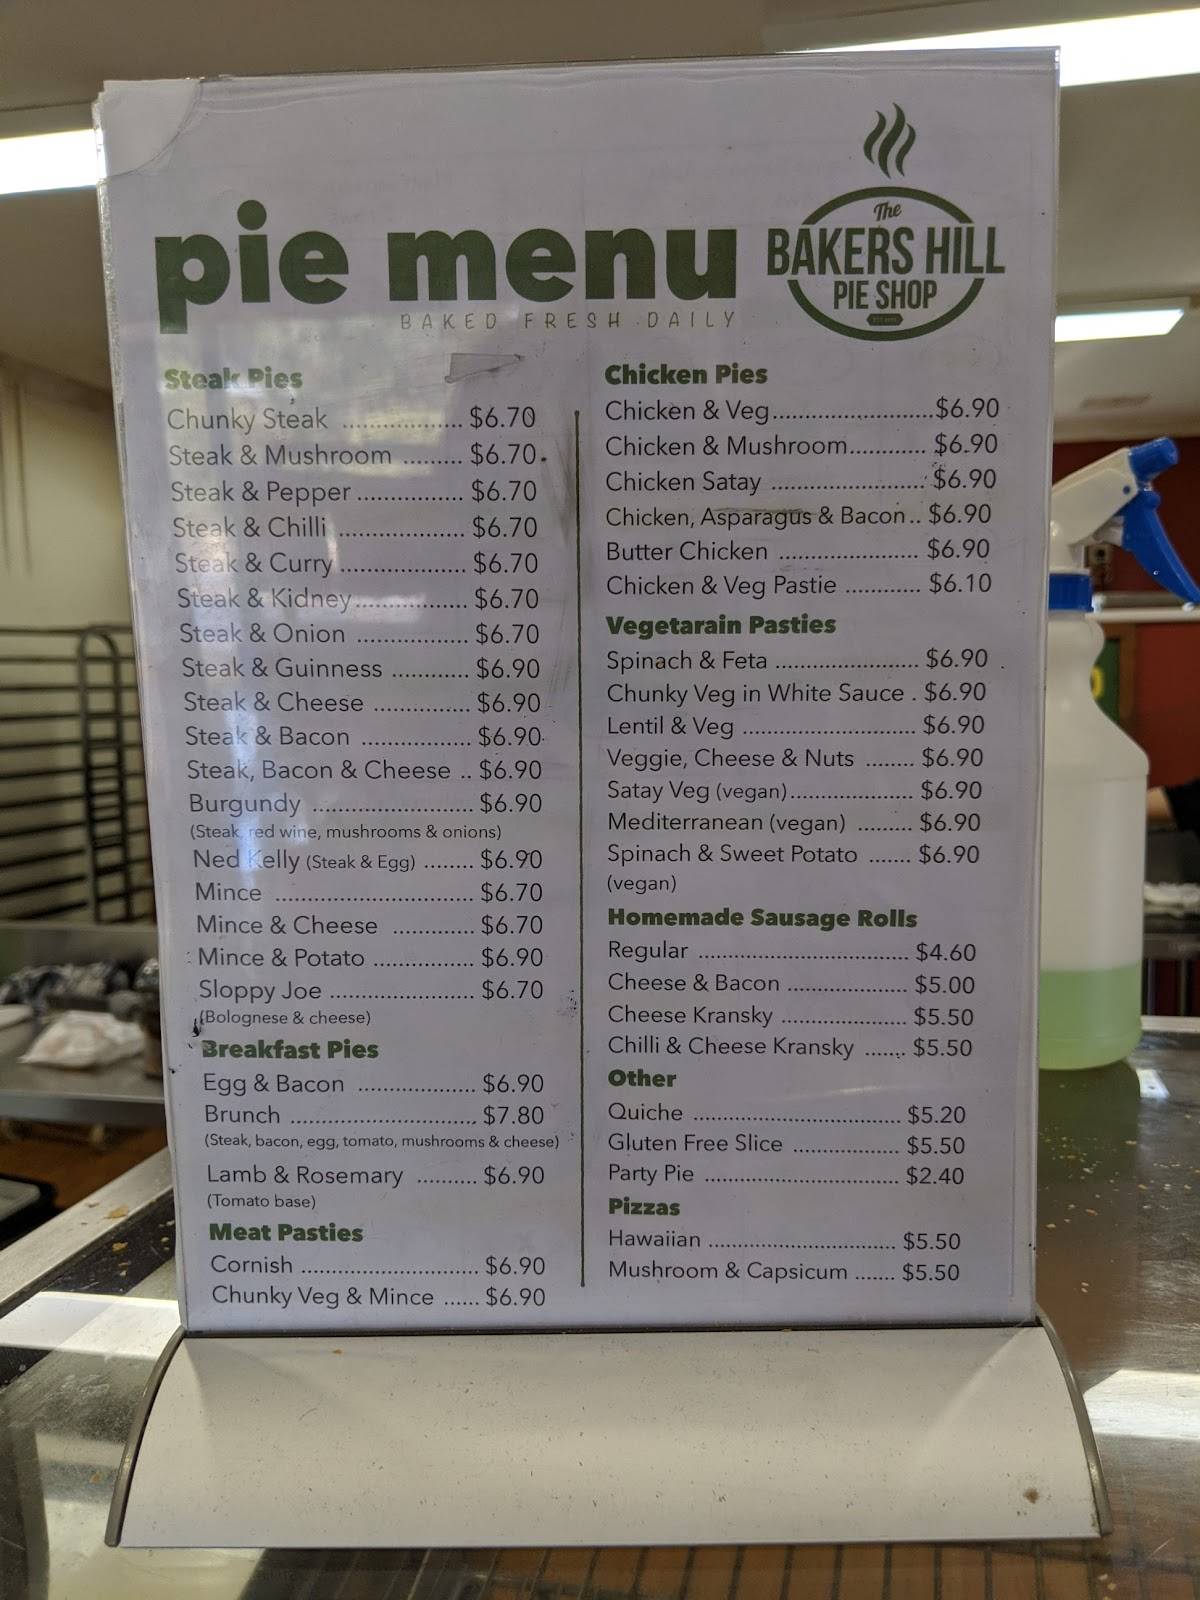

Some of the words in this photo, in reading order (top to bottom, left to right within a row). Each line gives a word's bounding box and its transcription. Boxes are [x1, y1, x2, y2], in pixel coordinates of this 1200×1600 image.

[874, 202, 901, 221] The
[767, 226, 914, 275] BAKERS
[926, 227, 1005, 274] HILL
[154, 199, 349, 334] pie
[387, 227, 737, 304] menu
[834, 281, 868, 309] PIE
[876, 280, 937, 309] SHOP
[401, 313, 499, 330] BAKED
[525, 312, 623, 328] FRESH
[647, 311, 735, 329] DAILY
[165, 368, 240, 390] Steak
[248, 366, 302, 388] Pies
[605, 363, 707, 385] Chicken
[716, 362, 768, 384] Pies
[168, 408, 255, 435] Chunky
[264, 407, 328, 429] Steak
[606, 400, 695, 420] Chicken
[726, 400, 768, 425] Veg
[936, 396, 999, 420] $6.90
[266, 444, 391, 465] Mushroom
[606, 435, 694, 456] Chicken
[728, 434, 846, 455] Mushroom
[268, 481, 351, 507] Pepper
[606, 471, 694, 491] Chicken
[703, 471, 761, 496] Satay
[268, 516, 325, 537] Chilli
[606, 507, 694, 528] Chicken,
[701, 508, 811, 531] Asparagus
[842, 507, 905, 524] Bacon
[929, 502, 991, 525] $6.90
[608, 542, 673, 560] Butter
[680, 540, 767, 560] Chicken
[928, 537, 989, 560] $6.90
[270, 552, 331, 578] Curry
[607, 575, 693, 595] Chicken
[723, 576, 765, 599] Veg
[775, 575, 836, 594] Pastie
[930, 572, 991, 594] $6.10
[272, 587, 351, 613] Kidney
[274, 623, 344, 643] Onion
[606, 614, 741, 640] Vegetarain
[749, 613, 836, 634] Pasties
[276, 658, 382, 677] Guinness
[608, 650, 691, 675] Spinach
[724, 651, 766, 669] Feta
[278, 692, 363, 711] Cheese
[608, 683, 688, 707] Chunky
[694, 684, 734, 707] Veg
[744, 685, 760, 702] in
[768, 683, 831, 701] White
[839, 683, 904, 701] Sauce
[925, 681, 986, 703] $6.90
[280, 726, 349, 745] Bacon
[609, 716, 663, 734] Lentil
[693, 717, 733, 739] Veg
[263, 760, 332, 779] Bacon
[365, 759, 450, 779] Cheese
[480, 759, 541, 780] $6.90
[607, 749, 687, 771] Veggie,
[695, 748, 774, 766] Cheese
[806, 749, 854, 766] Nuts
[608, 781, 663, 803] Satay
[669, 781, 709, 803] Veg
[717, 783, 786, 803] (vegan)
[190, 792, 300, 817] Burgundy
[480, 792, 541, 814] $6.90
[249, 824, 275, 838] red
[280, 825, 321, 840] wine,
[327, 824, 421, 838] mushrooms
[443, 825, 501, 840] onions)
[609, 812, 762, 830] Mediterranean
[770, 814, 845, 835] (vegan)
[194, 848, 239, 868] Ned
[247, 849, 300, 874] Kelly
[307, 854, 355, 871] (Steak
[379, 855, 415, 872] Egg)
[608, 843, 690, 867] Spinach
[720, 844, 784, 862] Sweet
[792, 845, 857, 862] Potato
[196, 882, 261, 901] Mince
[481, 882, 542, 903] $6.70
[608, 875, 676, 894] (vegan)
[197, 915, 262, 934] Mince
[294, 915, 377, 934] Cheese
[609, 907, 744, 926] Homemade
[750, 908, 850, 931] Sausage
[858, 909, 917, 928] Rolls
[199, 947, 264, 966] Mince
[295, 949, 364, 967] Potato
[482, 947, 543, 968] $6.90
[609, 940, 688, 963] Regular
[916, 942, 976, 962] $4.60
[200, 979, 275, 1004] Sloppy
[281, 981, 321, 999] Joe
[482, 979, 543, 1000] $6.70
[609, 972, 686, 991] Cheese
[716, 974, 779, 991] Bacon
[915, 974, 975, 994] $5.00
[200, 1009, 287, 1027] (Bolognese
[310, 1010, 370, 1026] cheese)
[609, 1004, 686, 1023] Cheese
[694, 1005, 773, 1028] Kransky
[914, 1006, 973, 1026] $5.50
[202, 1039, 320, 1059] Breakfast
[328, 1039, 379, 1058] Pies
[609, 1035, 658, 1053] Chilli
[689, 1036, 766, 1054] Cheese
[774, 1037, 854, 1061] Kransky
[913, 1037, 972, 1057] $5.50
[204, 1073, 246, 1096] Egg
[277, 1074, 343, 1092] Bacon
[483, 1073, 543, 1094] $6.90
[608, 1069, 676, 1087] Other
[205, 1105, 280, 1123] Brunch
[484, 1105, 543, 1126] $7.80
[608, 1103, 682, 1121] Quiche
[908, 1105, 965, 1125] $5.20
[205, 1133, 251, 1148] (Steak,
[256, 1134, 302, 1149] bacon,
[307, 1138, 338, 1150] egg,
[343, 1136, 397, 1148] tomato,
[402, 1134, 484, 1148] mushrooms
[504, 1136, 559, 1149] cheese)
[609, 1133, 676, 1151] Gluten
[685, 1134, 728, 1151] Free
[736, 1133, 782, 1152] Slice
[907, 1136, 965, 1155] $5.50
[208, 1164, 266, 1183] Lamb
[297, 1166, 403, 1188] Rosemary
[484, 1165, 544, 1186] $6.90
[610, 1164, 657, 1186] Party
[665, 1165, 693, 1182] Pie
[906, 1166, 964, 1185] $2.40
[208, 1193, 269, 1208] (Tomato
[275, 1194, 315, 1210] base)
[609, 1197, 680, 1216] Pizzas
[210, 1223, 271, 1241] Meat
[278, 1223, 363, 1242] Pasties
[610, 1229, 700, 1247] Hawaiian
[904, 1232, 960, 1251] $5.50
[211, 1255, 292, 1273] Cornish
[486, 1256, 545, 1276] $6.90
[610, 1260, 717, 1278] Mushroom
[747, 1262, 847, 1284] Capsicum
[903, 1263, 959, 1282] $5.50
[213, 1285, 292, 1309] Chunky
[297, 1287, 338, 1309] Veg
[370, 1288, 433, 1305] Mince
[486, 1286, 545, 1306] $6.90
